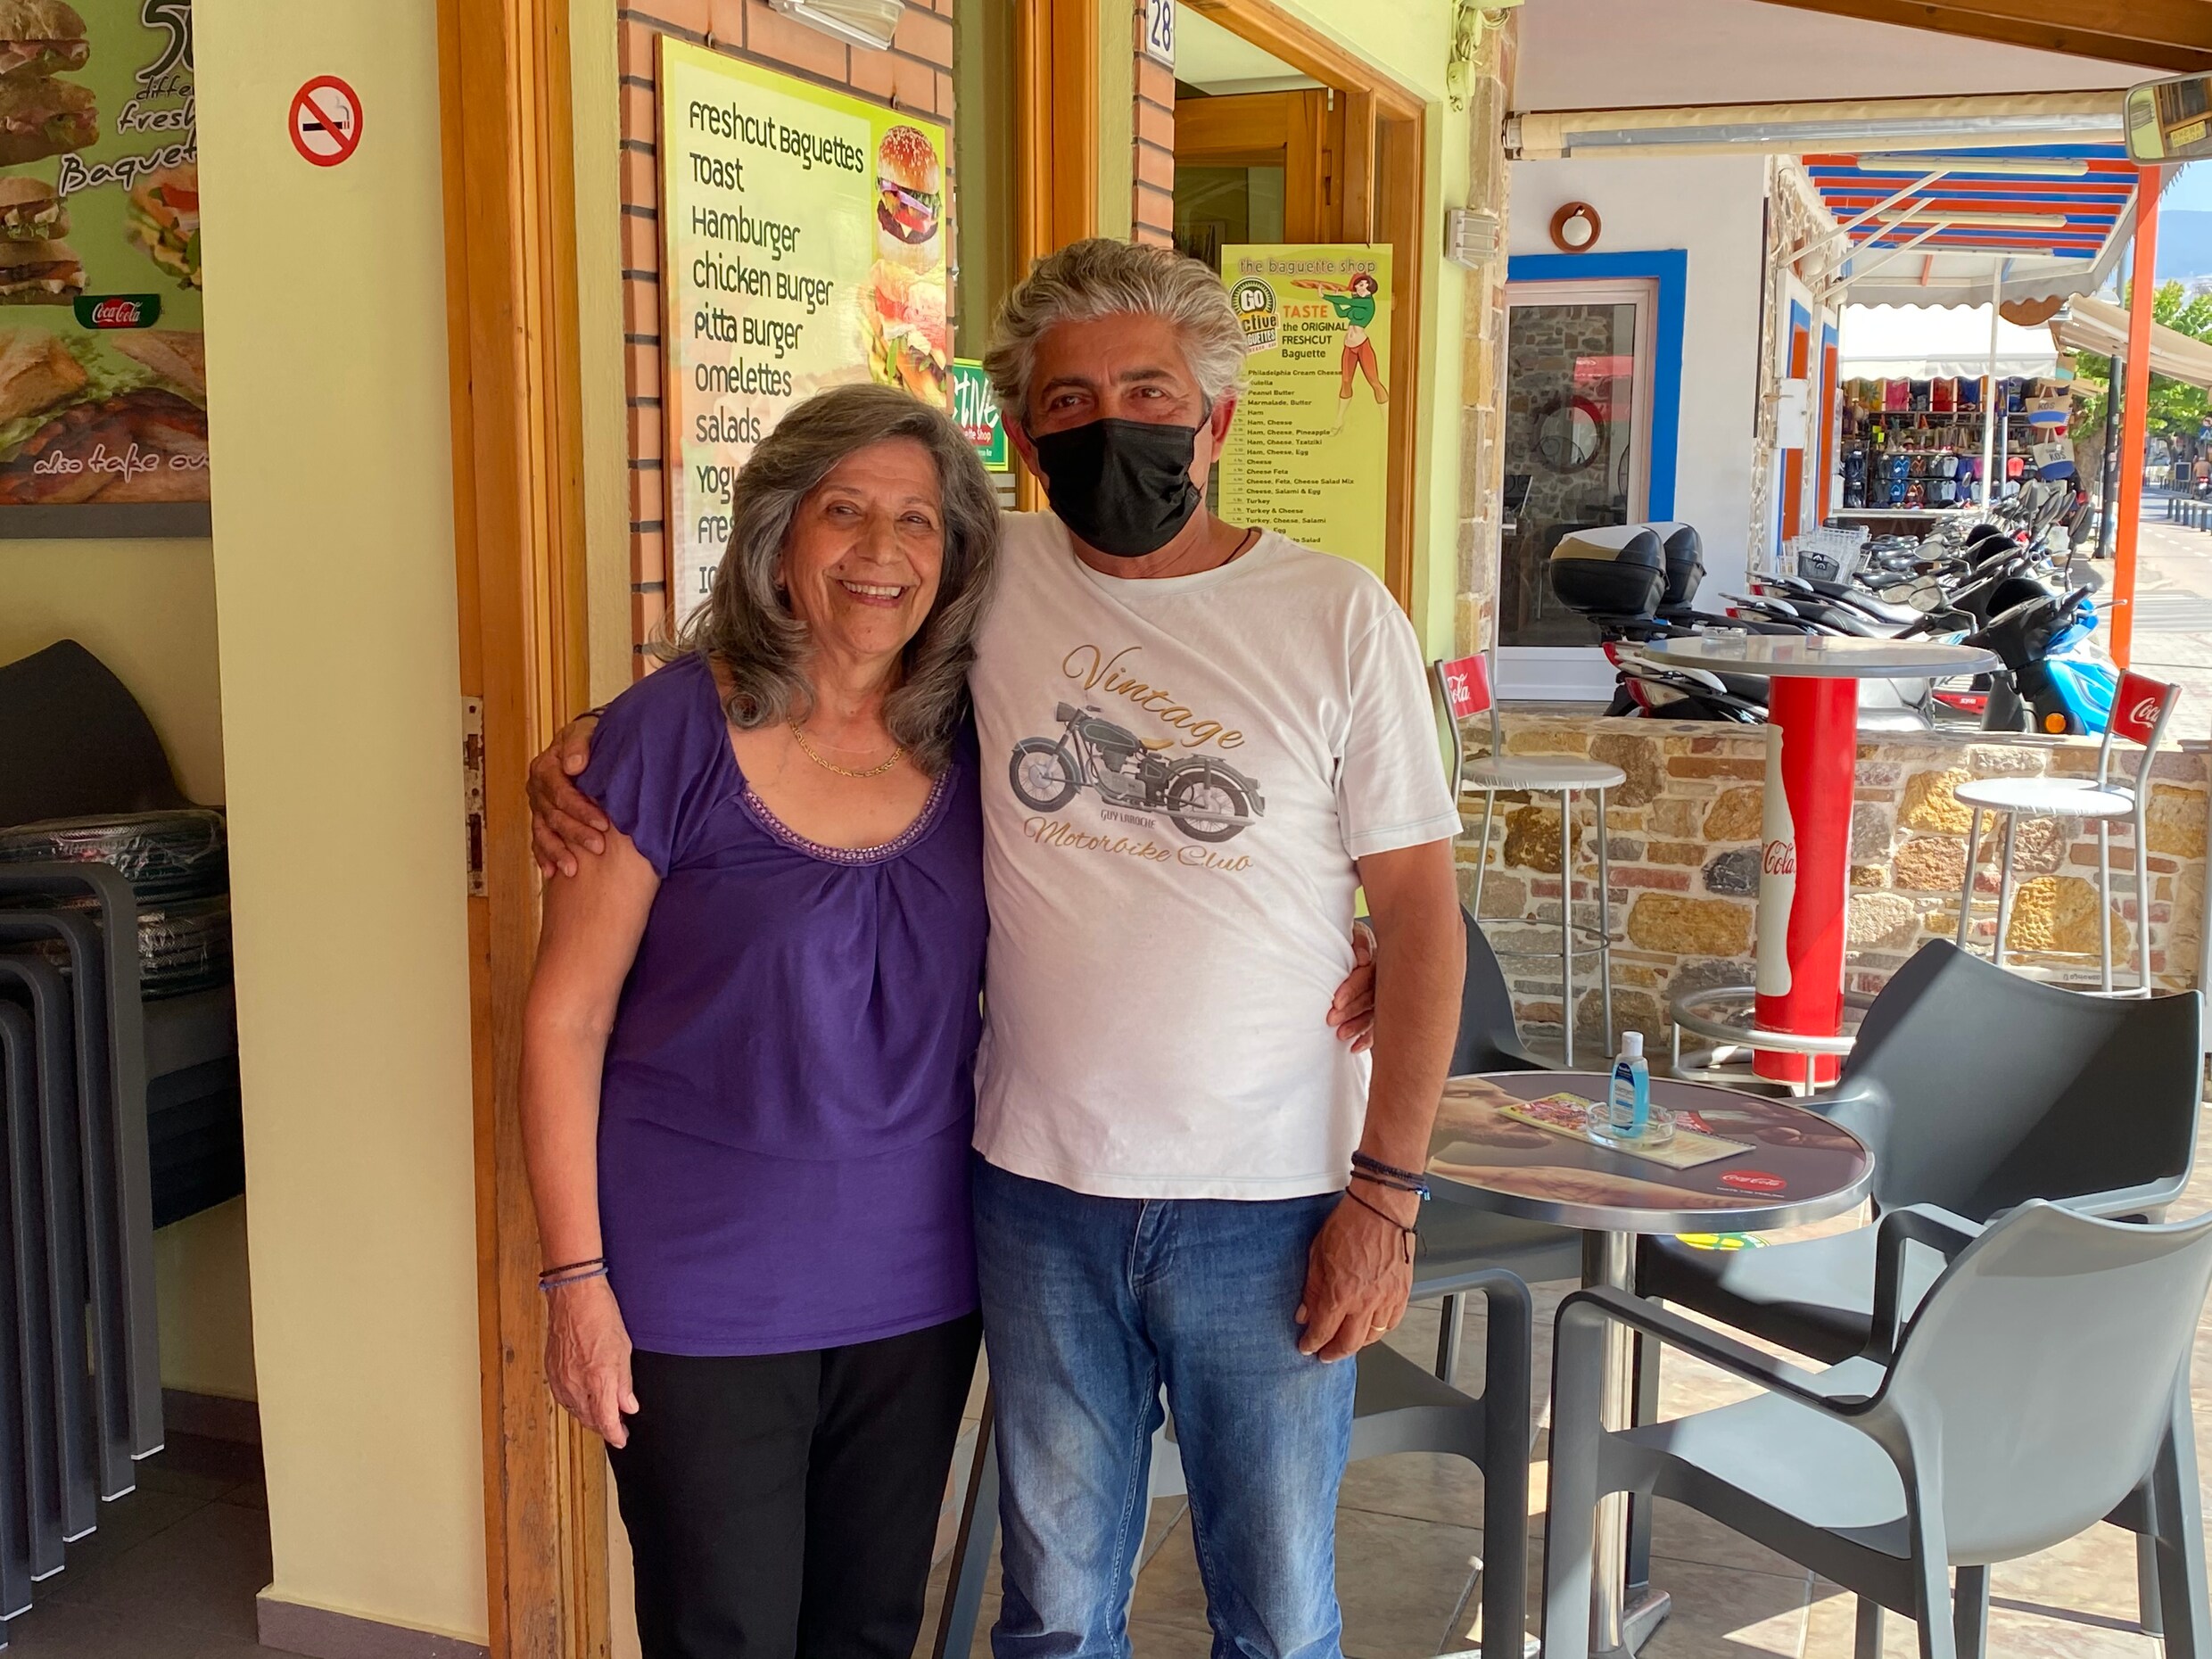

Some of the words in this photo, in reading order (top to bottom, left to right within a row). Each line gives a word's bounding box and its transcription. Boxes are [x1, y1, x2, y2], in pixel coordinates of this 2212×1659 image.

[1151, 0, 1171, 52] 28
[136, 76, 194, 100] diffe
[689, 100, 777, 152] Freshcut
[780, 124, 864, 173] Baguettes
[689, 152, 745, 192] Toast
[692, 204, 800, 260] Hamburger
[1239, 260, 1263, 273] the
[1268, 259, 1334, 275] baguette
[1340, 260, 1376, 274] shop
[777, 271, 834, 315] Burger
[1241, 290, 1265, 311] GO
[1283, 305, 1328, 318] TASTE
[1242, 314, 1276, 332] ctive
[1283, 322, 1299, 332] the
[1301, 321, 1348, 332] ORIGINAL
[743, 316, 804, 359] Burger
[1247, 328, 1276, 346] GUETTES
[1282, 335, 1333, 345] FRESHCUT
[1282, 349, 1326, 360] Baguette
[34, 450, 83, 475] also
[88, 443, 160, 483] take
[2049, 451, 2067, 461] KOS
[1062, 644, 1245, 748] Vintage
[1100, 809, 1118, 822] GUY
[1119, 813, 1157, 830] LAROCHE
[1023, 816, 1172, 863] Motorbike
[1176, 845, 1254, 871] Club
